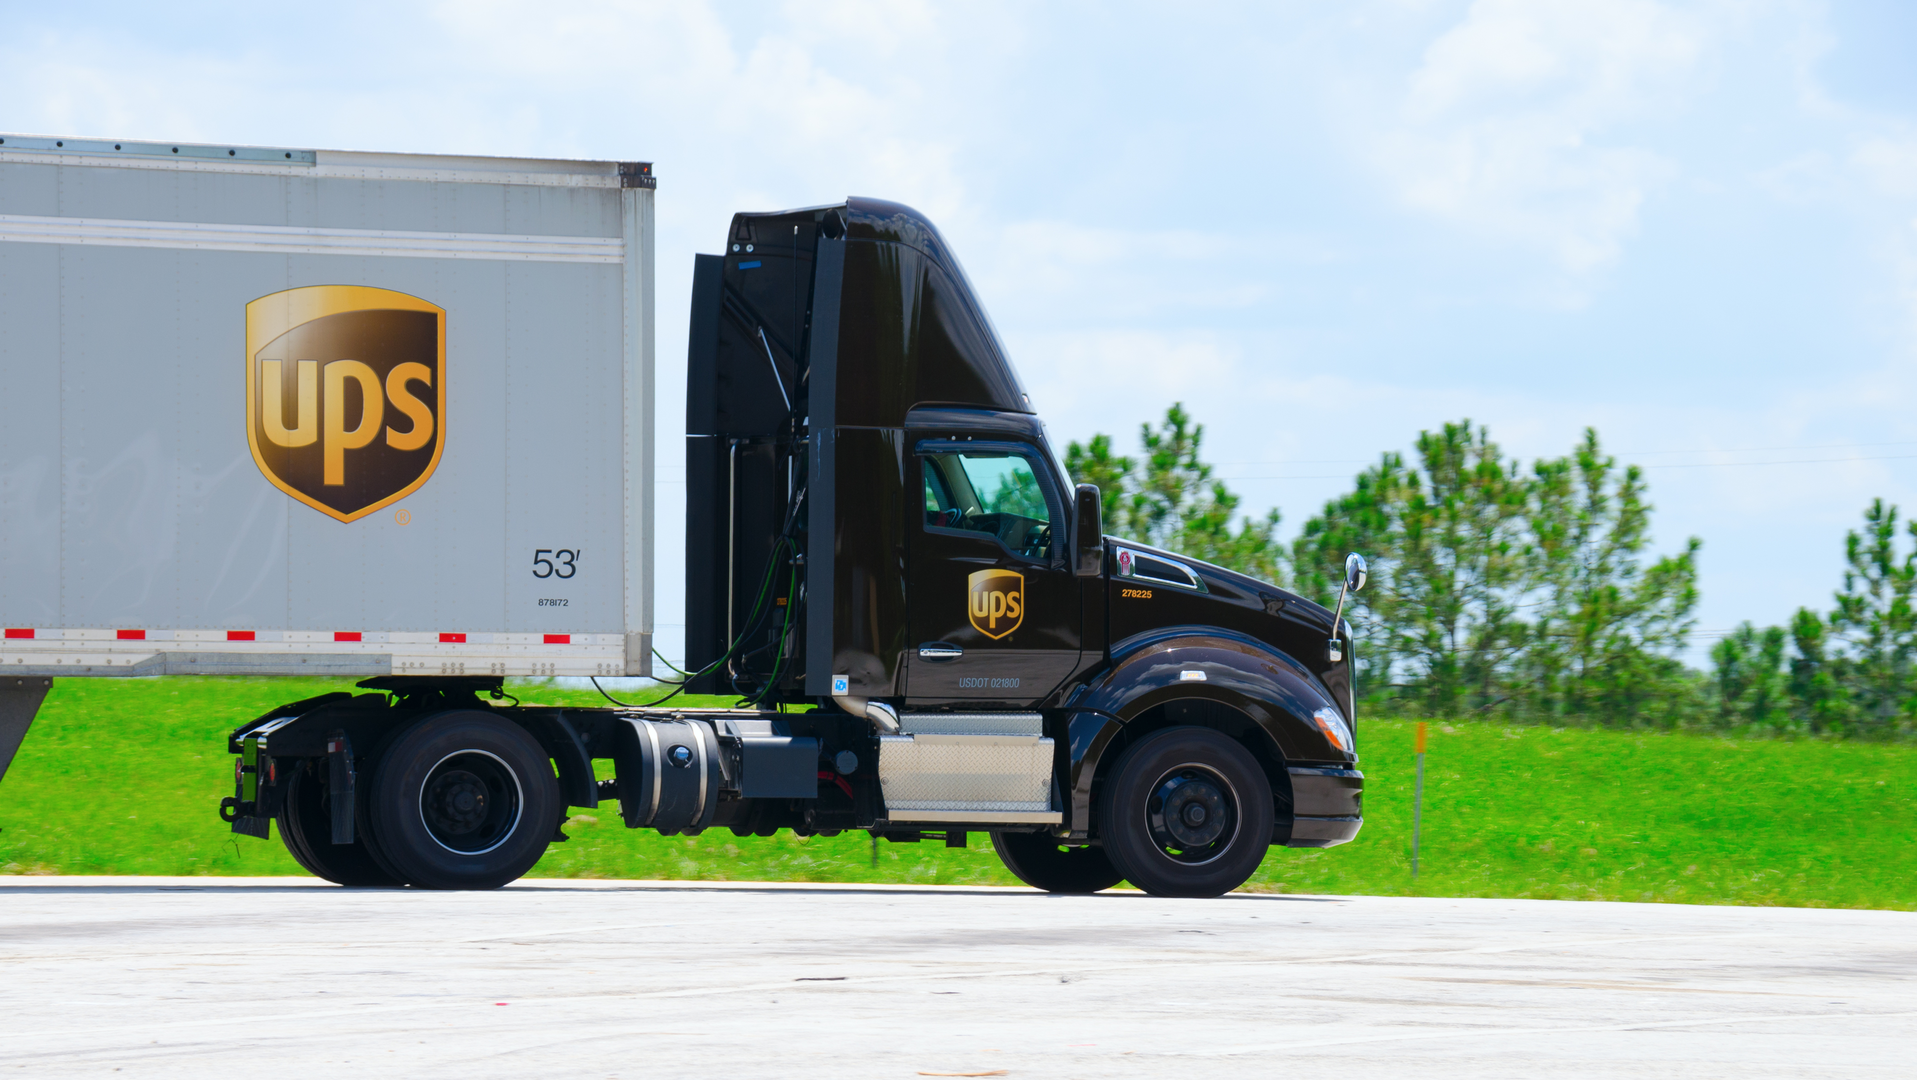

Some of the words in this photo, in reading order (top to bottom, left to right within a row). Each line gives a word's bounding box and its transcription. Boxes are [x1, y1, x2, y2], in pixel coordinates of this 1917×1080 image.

[261, 359, 435, 487] ups
[1121, 588, 1153, 599] 278225
[538, 598, 569, 607] 878172
[972, 590, 1021, 629] ups
[958, 677, 990, 689] USDOT
[990, 677, 1020, 689] 021800
